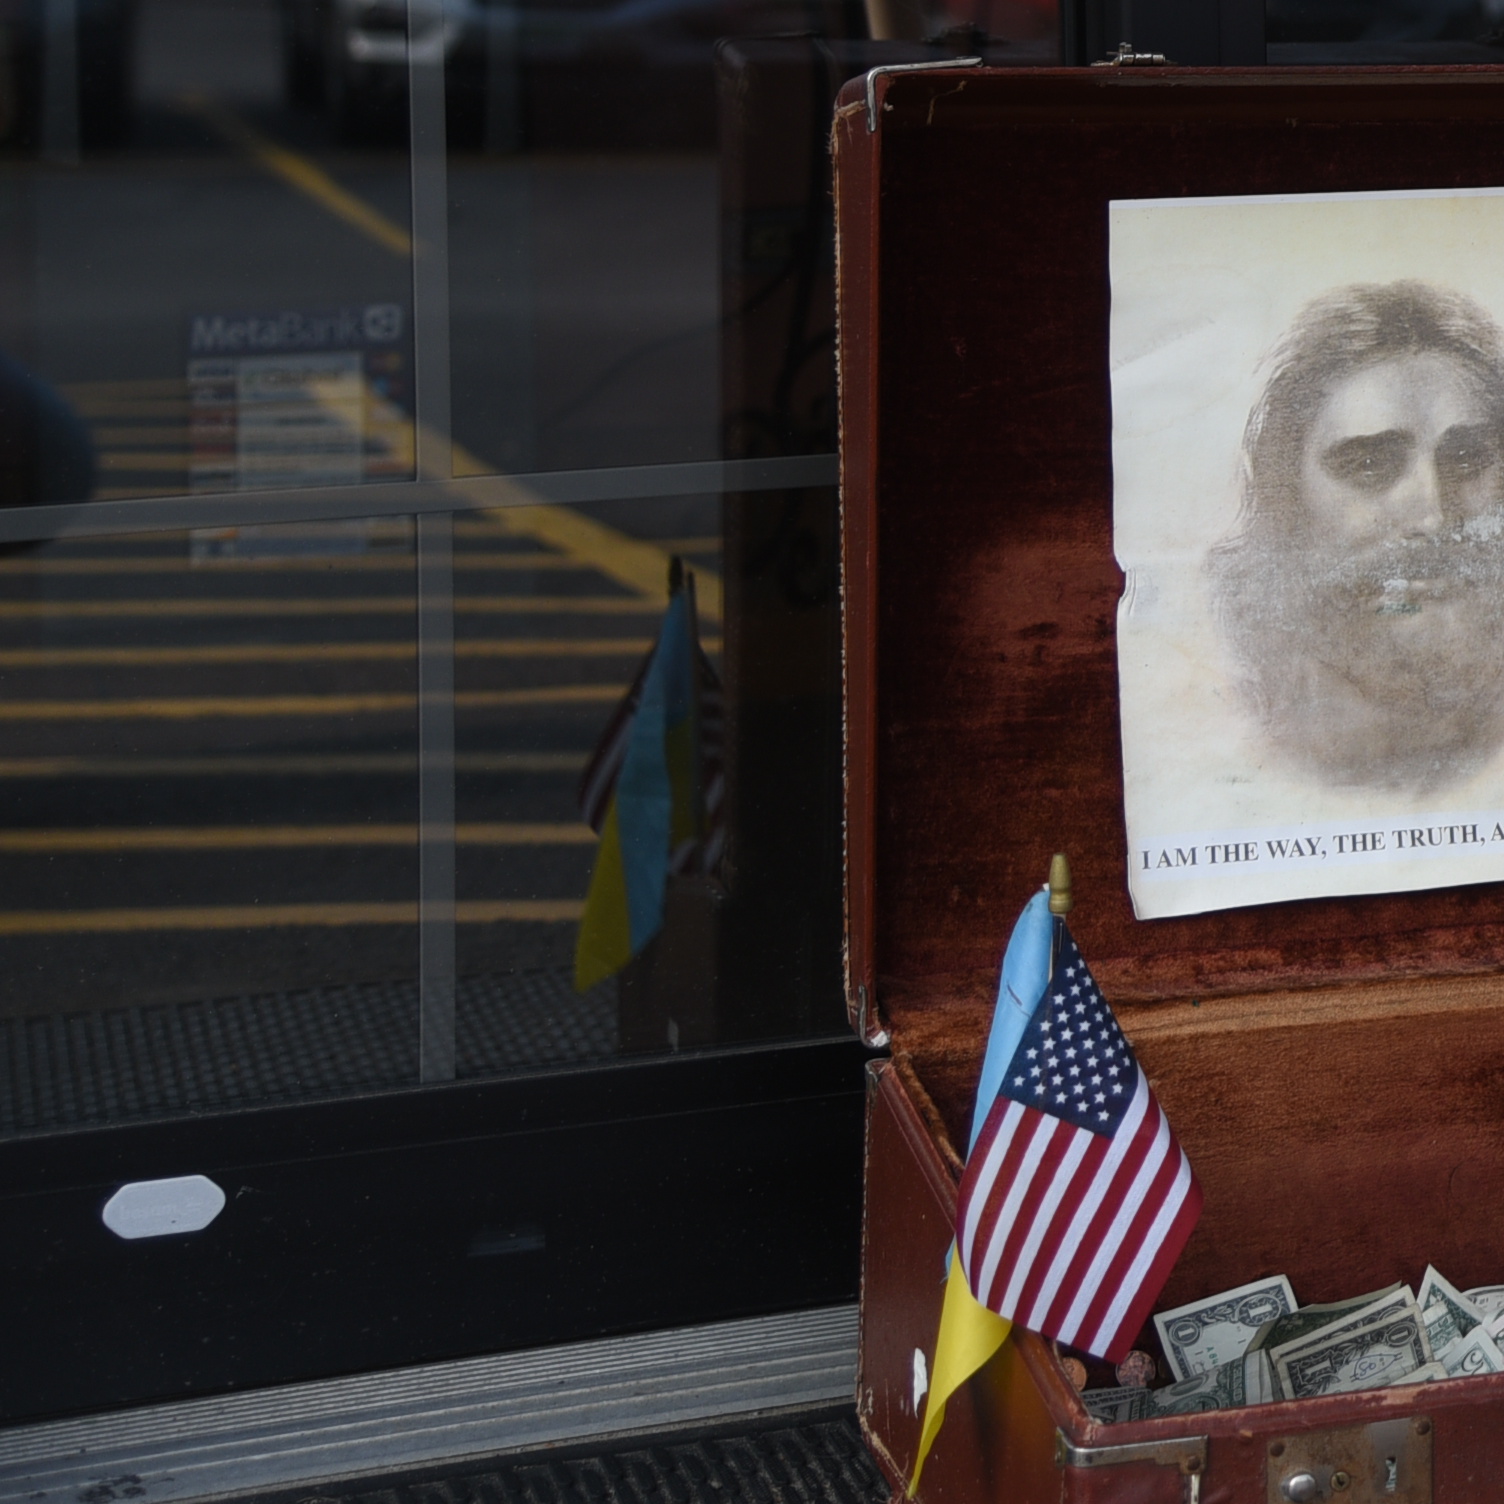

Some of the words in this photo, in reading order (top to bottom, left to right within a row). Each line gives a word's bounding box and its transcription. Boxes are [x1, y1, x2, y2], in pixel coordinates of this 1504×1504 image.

[1142, 850, 1151, 870] I
[1156, 848, 1199, 868] AM
[1205, 841, 1259, 865] THE
[1266, 835, 1328, 861] WAY,
[1333, 830, 1386, 855] THE
[1392, 822, 1486, 849] TRUTH,
